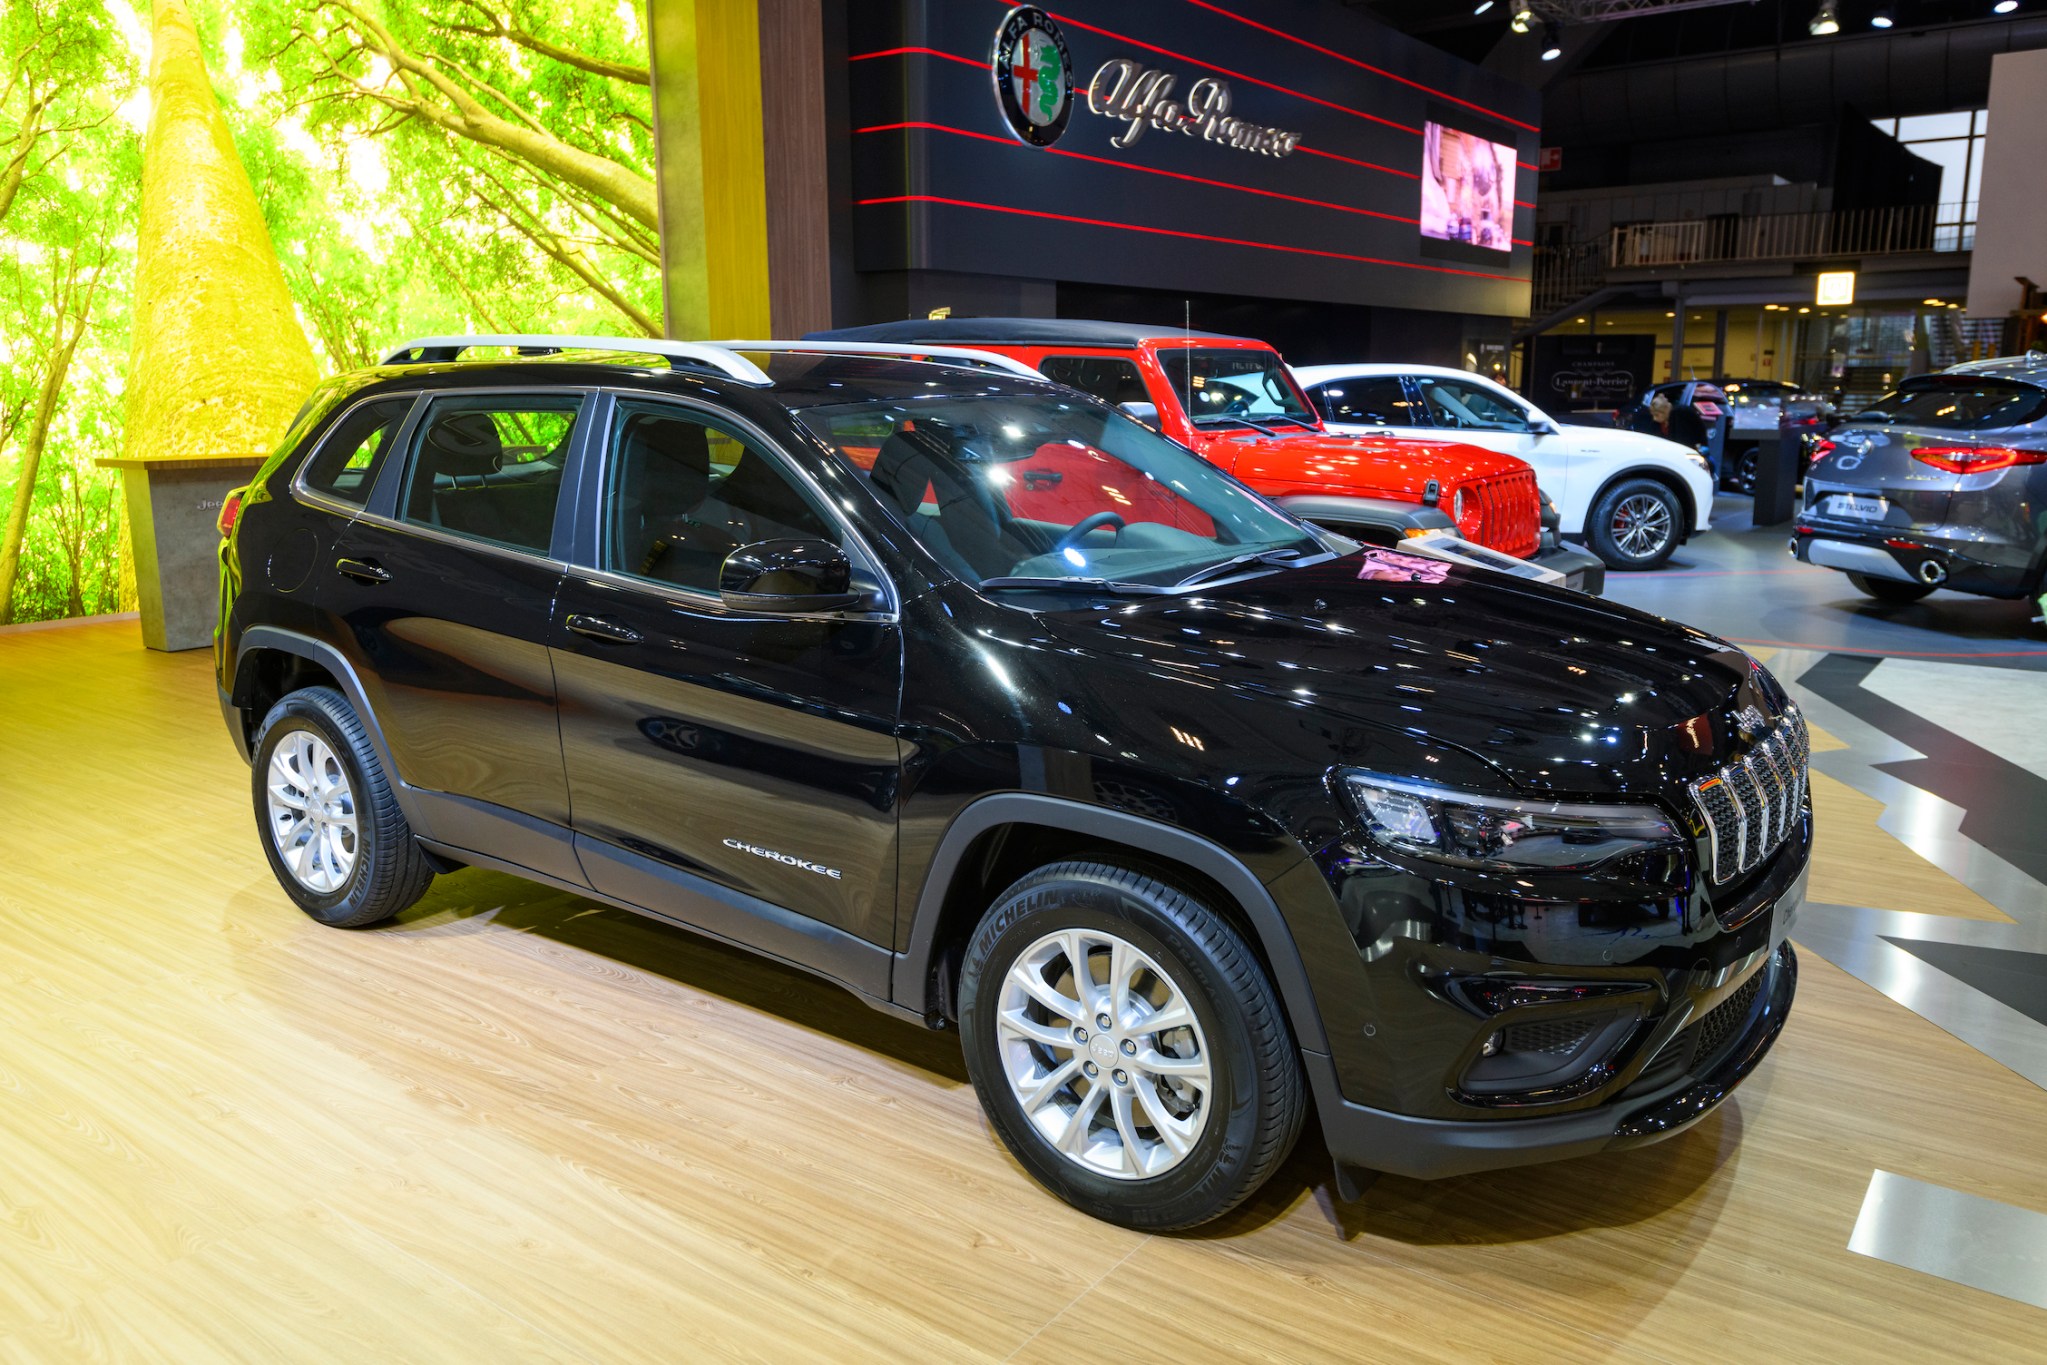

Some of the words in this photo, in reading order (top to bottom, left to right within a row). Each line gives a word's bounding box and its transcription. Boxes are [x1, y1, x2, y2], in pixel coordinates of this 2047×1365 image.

[999, 15, 1028, 70] ALFA
[1033, 12, 1074, 86] ROMEO
[1087, 58, 1184, 149] Alfa
[1184, 77, 1302, 157] Romeo
[196, 499, 224, 511] Jee
[722, 838, 842, 880] CHEROKEE
[978, 888, 1060, 957] MICHELIN
